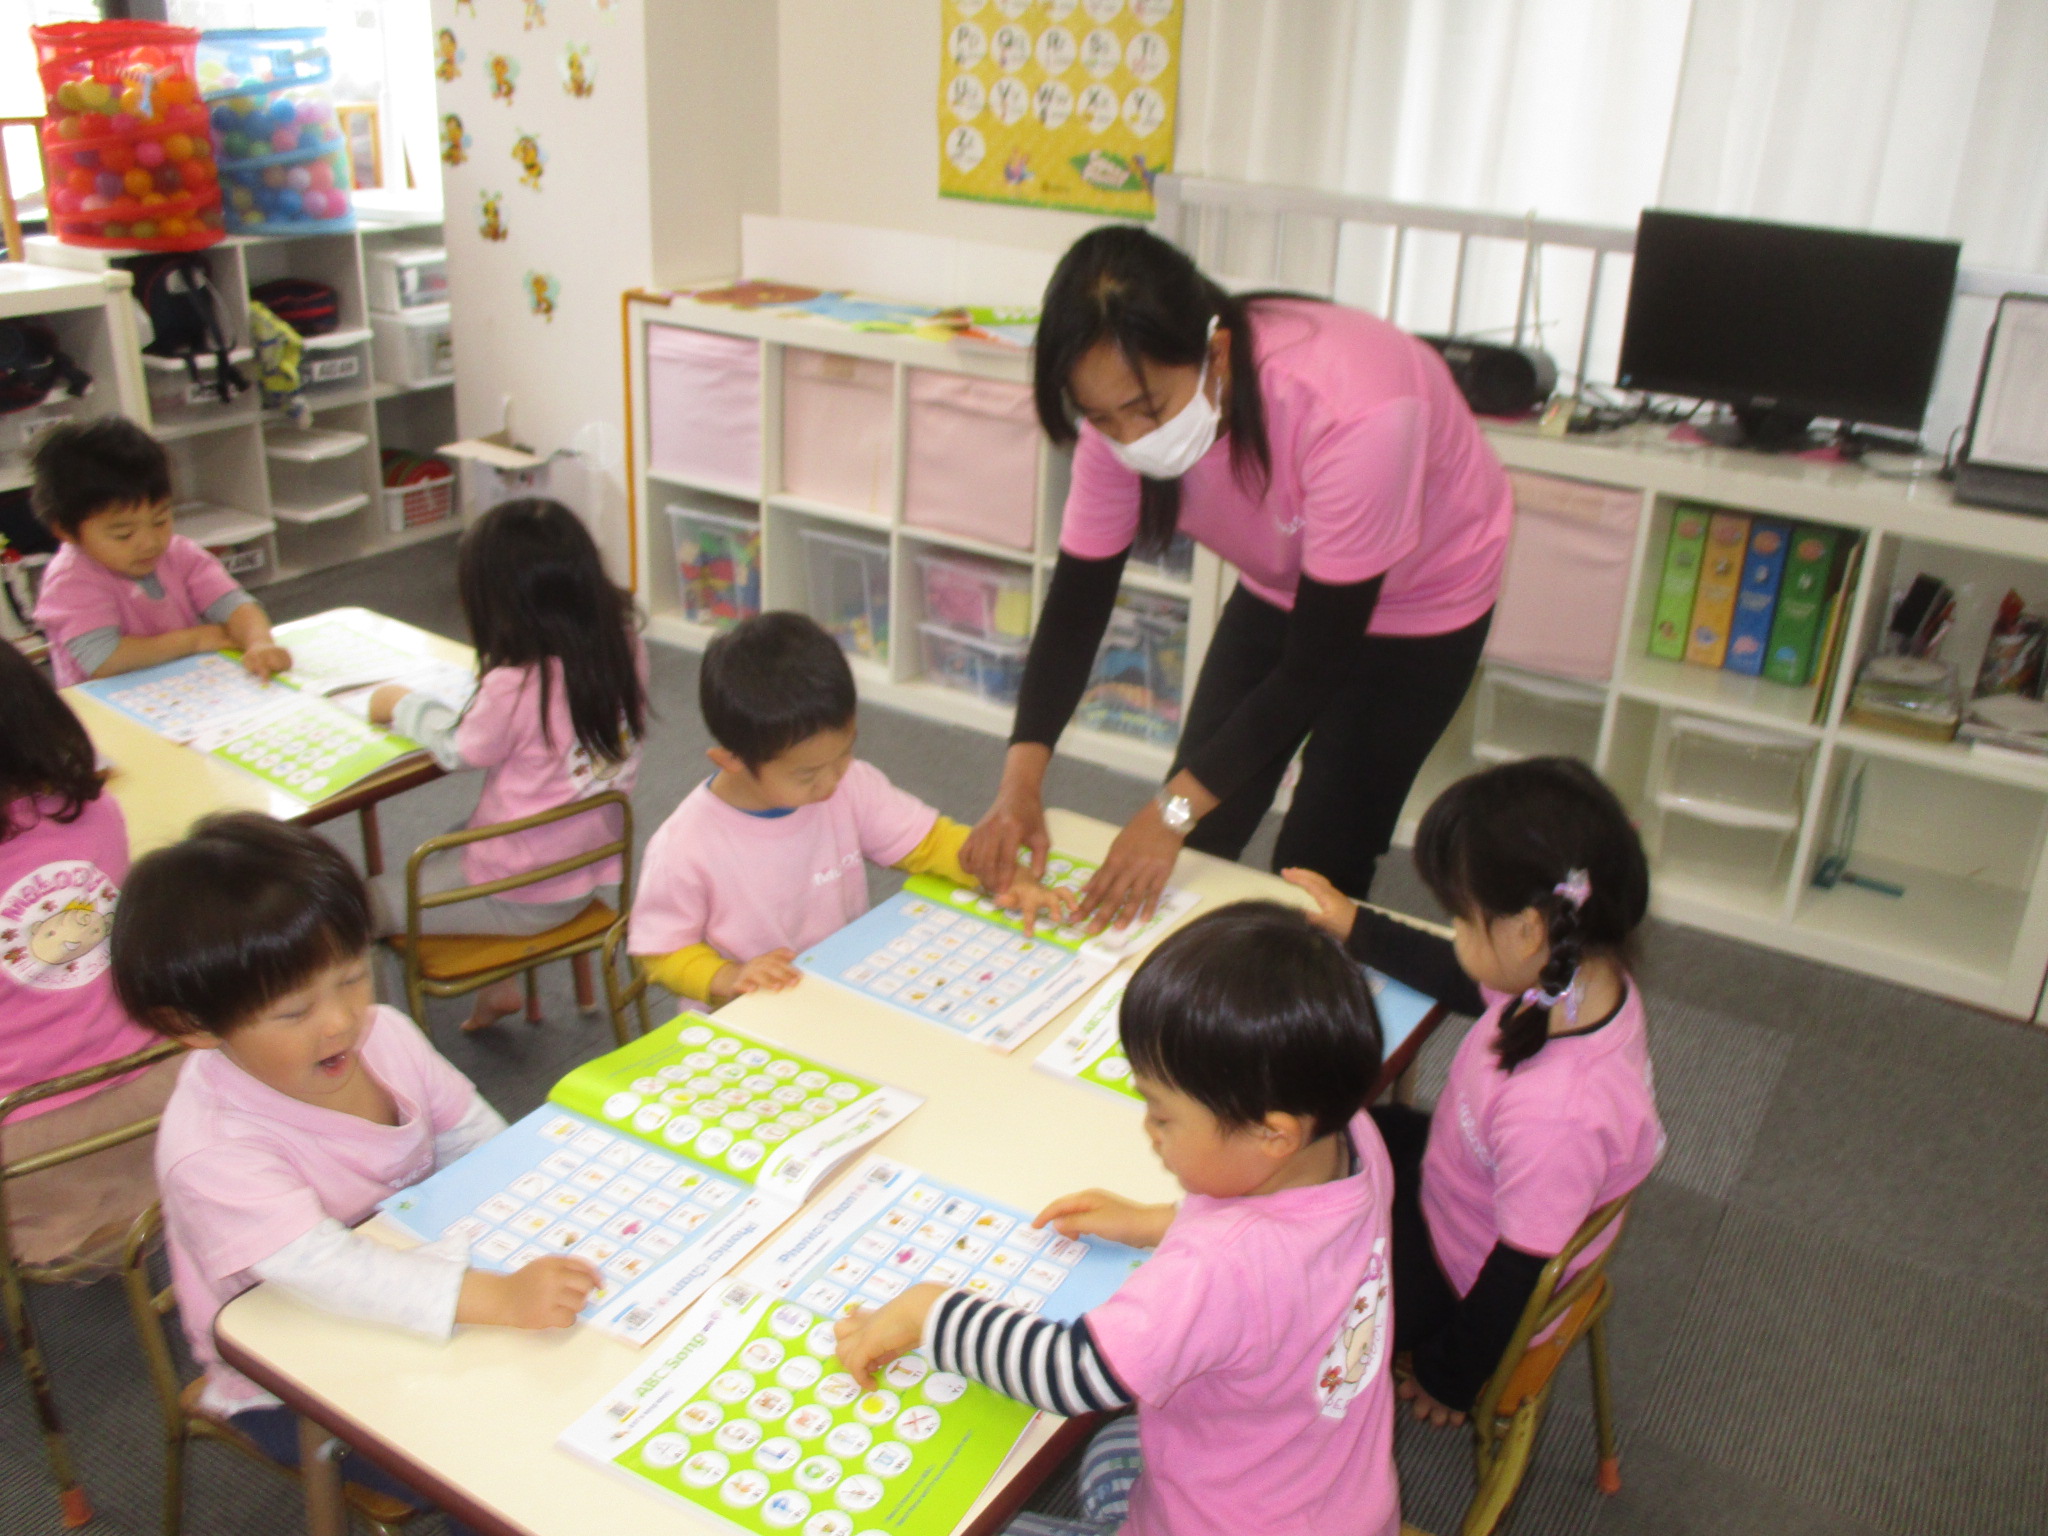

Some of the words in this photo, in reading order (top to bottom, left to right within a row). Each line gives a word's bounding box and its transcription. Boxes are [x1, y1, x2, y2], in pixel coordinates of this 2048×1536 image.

[777, 1223, 828, 1262] Phonics
[667, 1263, 710, 1297] Chant
[635, 1369, 670, 1397] ABC
[664, 1333, 708, 1370] Song
